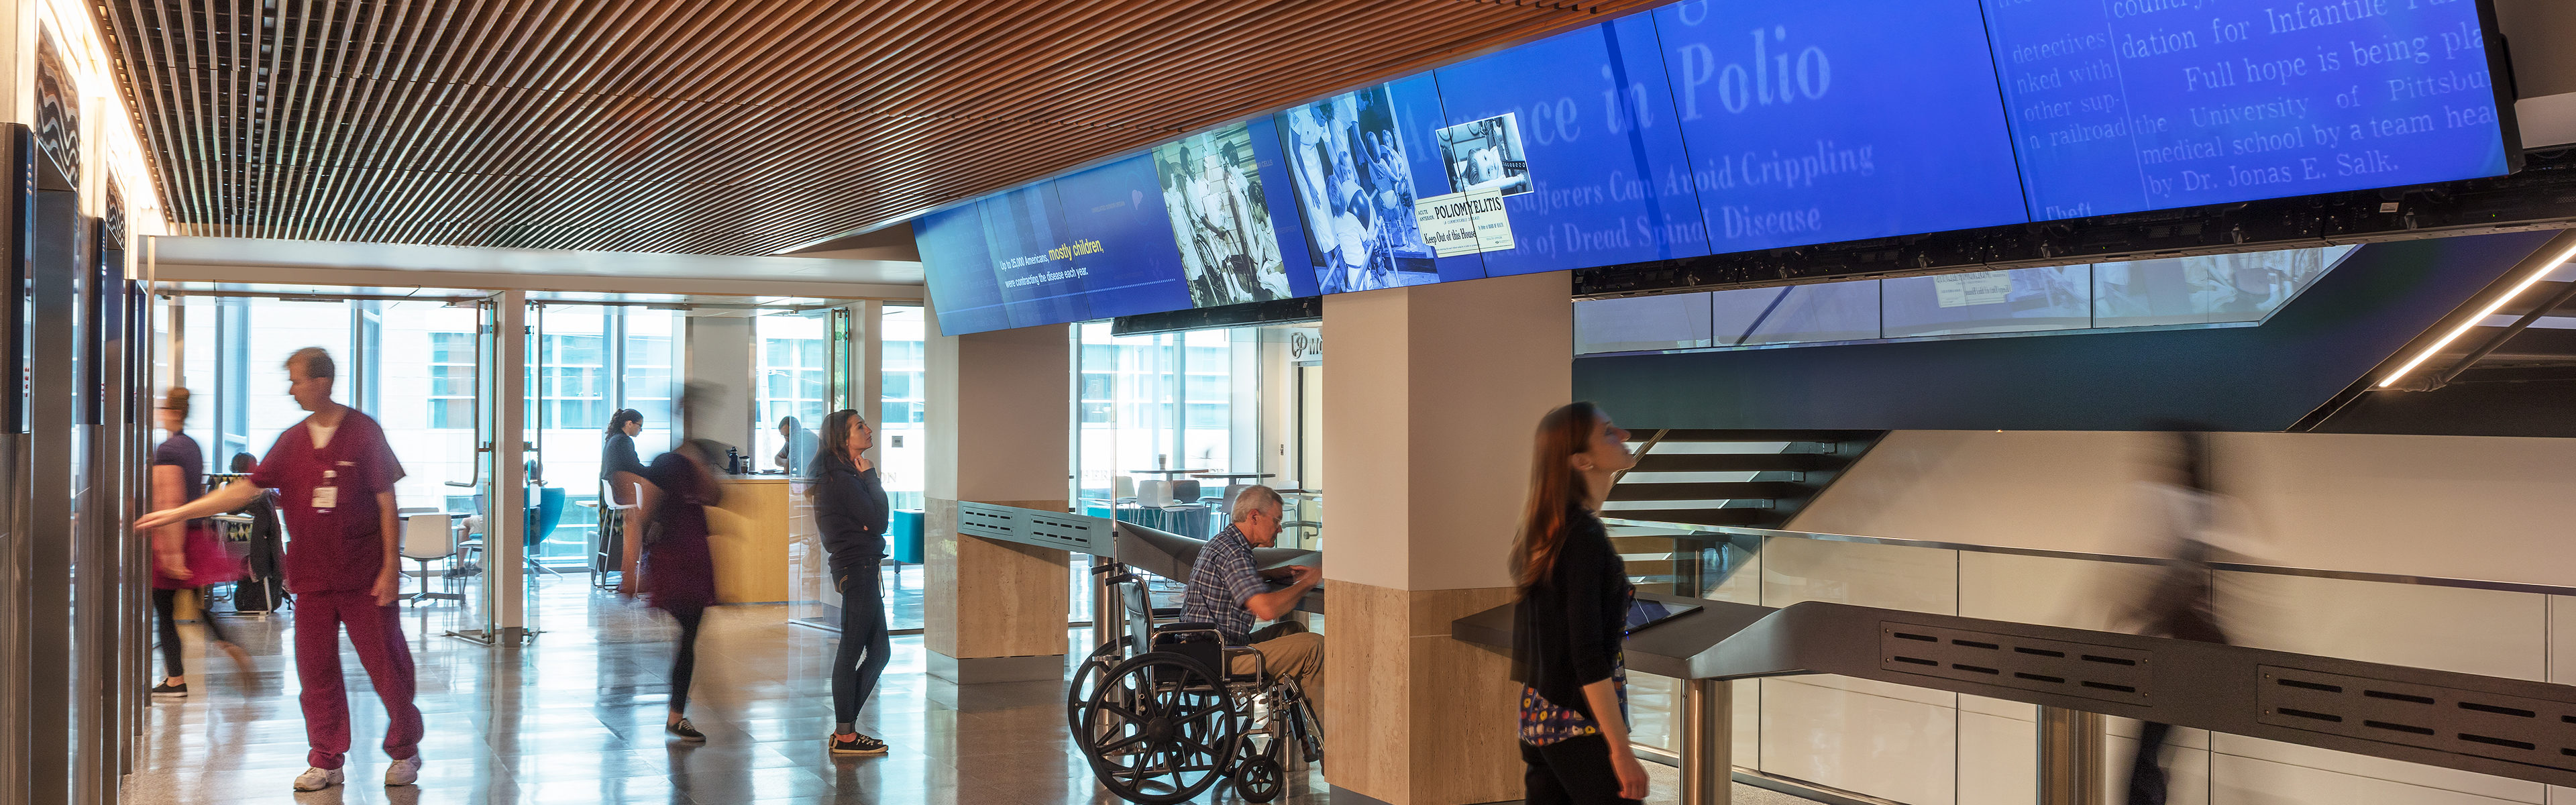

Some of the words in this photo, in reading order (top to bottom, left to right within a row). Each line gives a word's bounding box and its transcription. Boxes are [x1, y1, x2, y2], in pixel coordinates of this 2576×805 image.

[2012, 33, 2106, 64] detectives
[2122, 28, 2198, 59] dation
[2212, 17, 2250, 44] for
[1601, 64, 1654, 134] in
[1677, 25, 1831, 122] Polio
[2017, 68, 2062, 95] nked
[2069, 59, 2114, 84] with
[2183, 61, 2236, 92] Full
[2243, 57, 2308, 86] hope
[2317, 45, 2341, 72] is
[2349, 34, 2430, 66] being
[2024, 101, 2072, 122] other
[2080, 93, 2120, 113] sup-
[2135, 114, 2168, 135] the
[2190, 97, 2309, 128] University
[2336, 85, 2361, 108] of
[2049, 117, 2127, 147] railroad
[2143, 136, 2224, 165] medical
[2233, 126, 2305, 155] school
[2312, 123, 2341, 149] by
[2350, 123, 2364, 140] a
[2369, 117, 2435, 138] team
[1512, 180, 1604, 215] Sufferers
[1611, 170, 1654, 203] Can
[1664, 155, 1735, 197] Avoid
[1741, 139, 1876, 189] Crippling
[2149, 175, 2173, 199] by
[2182, 170, 2218, 191] Dr.
[2228, 165, 2293, 188] Jonas
[2300, 157, 2327, 180] E.
[2336, 150, 2399, 177] Salk.
[1434, 197, 1502, 219] POLIOMYELITIS
[1424, 233, 1436, 245] Keep
[1436, 231, 1446, 242] Out
[1446, 230, 1451, 241] of
[1451, 229, 1461, 240] this
[1460, 228, 1477, 239] House
[1537, 224, 1556, 260] of
[1564, 216, 1631, 253] Dread
[1637, 207, 1714, 255] Spinal
[1721, 205, 1823, 239] Disease
[1000, 260, 1007, 272] Up
[1011, 257, 1024, 270] 25,000
[1024, 253, 1049, 266] Americans,
[1049, 243, 1072, 261] mostly
[1073, 238, 1104, 256] children,
[1005, 278, 1016, 288] were
[1016, 274, 1040, 285] contracting
[1046, 271, 1064, 282] disease
[1064, 267, 1076, 278] each
[1076, 267, 1089, 278] year.
